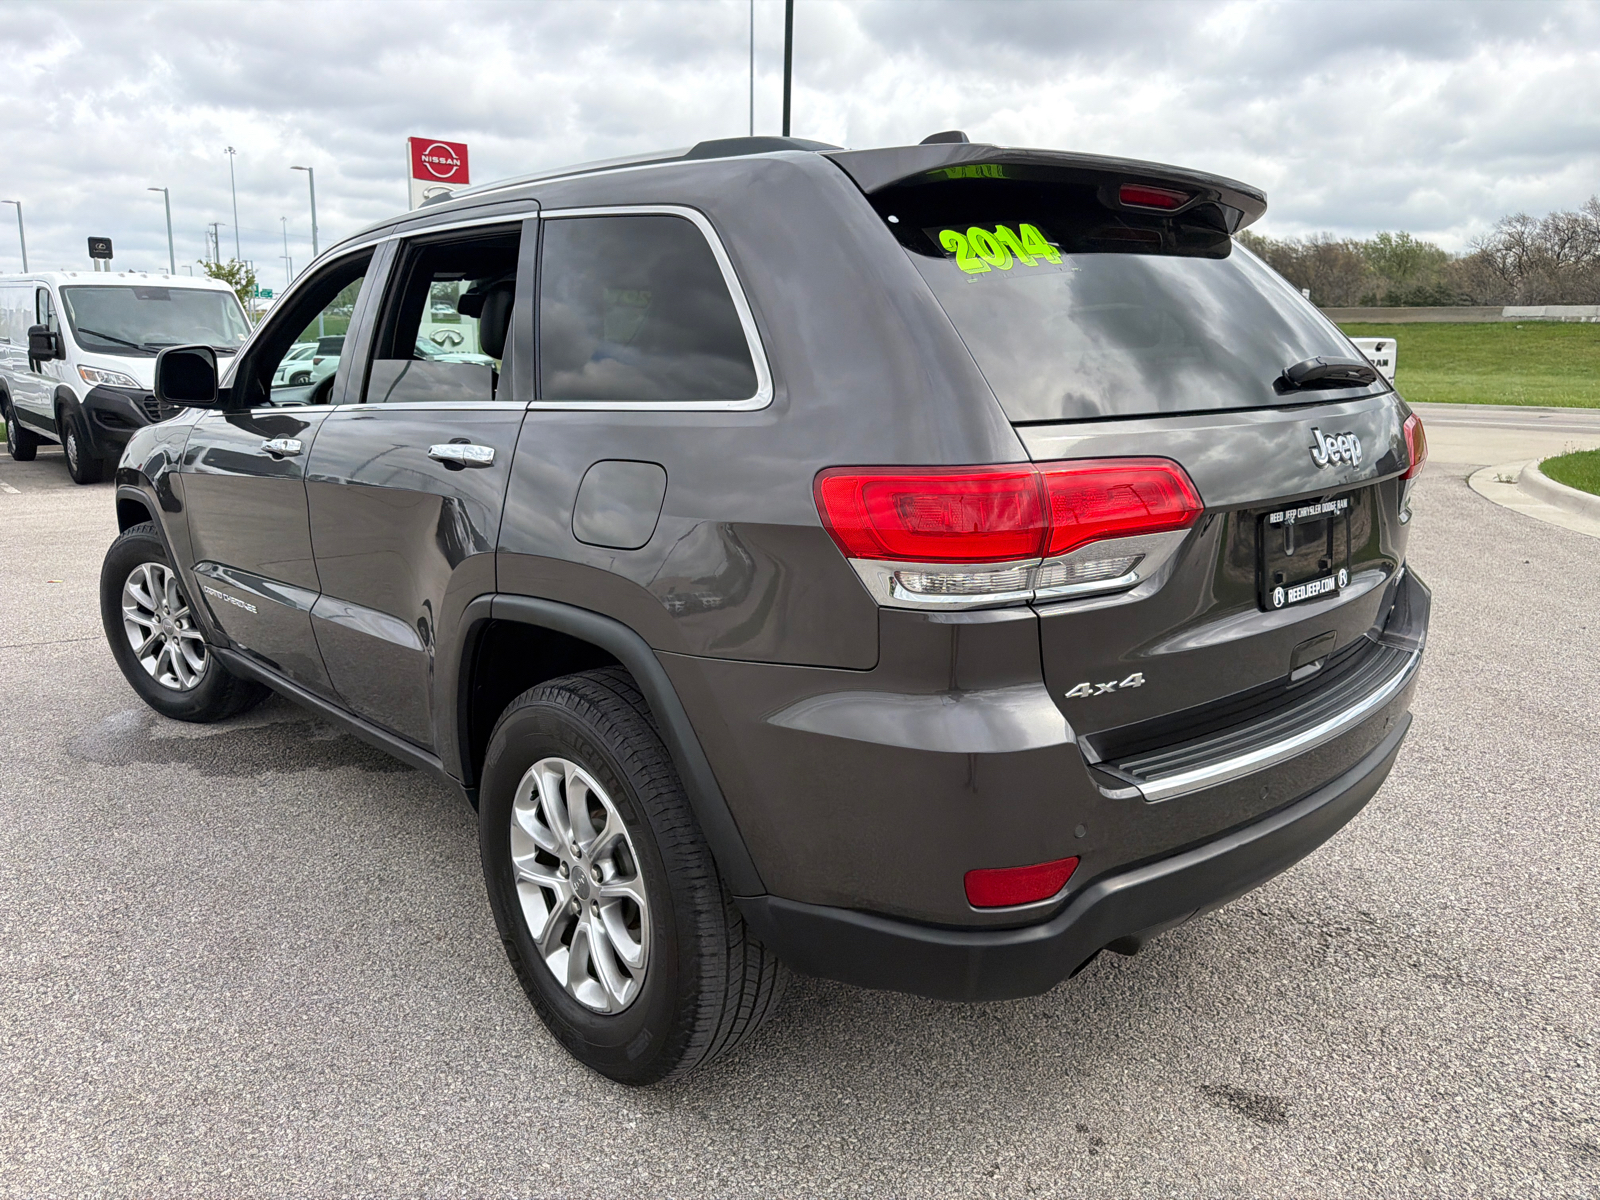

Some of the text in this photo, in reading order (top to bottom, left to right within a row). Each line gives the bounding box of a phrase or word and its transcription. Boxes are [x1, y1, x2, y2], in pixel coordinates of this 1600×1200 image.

[421, 155, 461, 166] NISSAN
[939, 224, 1063, 274] 2014
[1309, 427, 1362, 471] Jeep
[1269, 498, 1348, 524] REED JEEP CHRYSLER DODGE RAM
[1288, 576, 1335, 603] REEDJEEP.COM
[1064, 672, 1145, 698] 4x4
